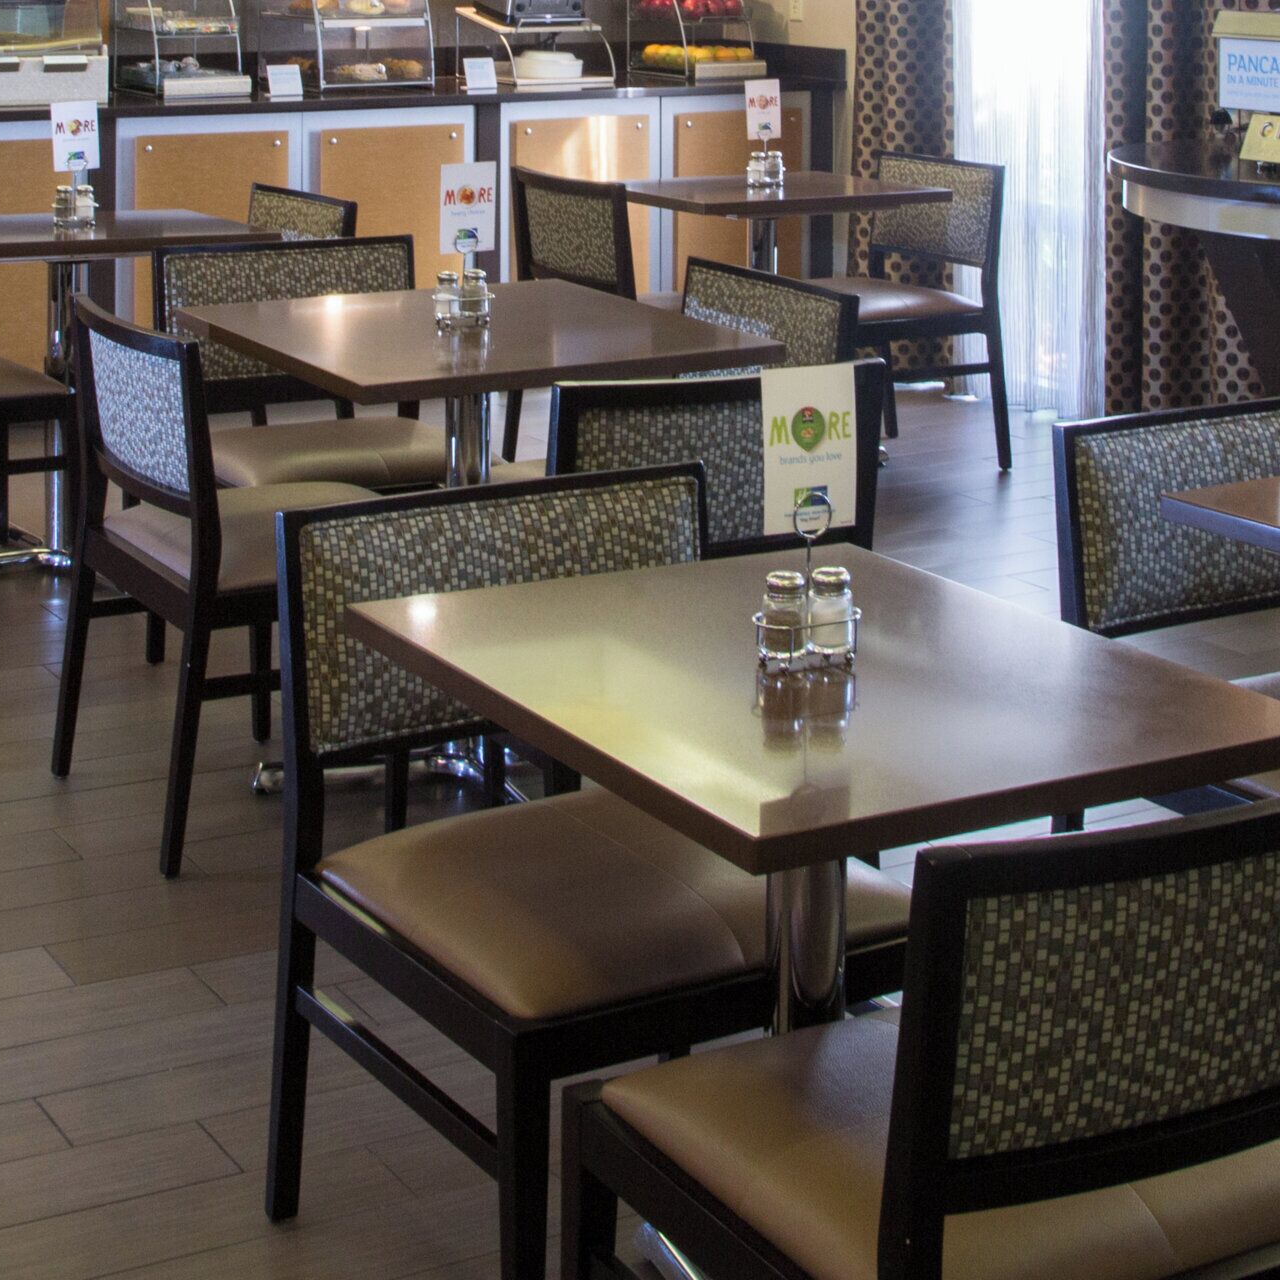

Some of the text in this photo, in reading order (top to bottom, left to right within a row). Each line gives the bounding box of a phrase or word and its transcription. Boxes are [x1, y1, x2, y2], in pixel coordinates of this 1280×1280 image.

[1227, 74, 1237, 85] IN
[1238, 75, 1245, 85] A
[1246, 76, 1278, 89] MINUTE
[444, 185, 493, 207] MORE
[770, 408, 852, 450] MORE
[779, 450, 842, 466] brands you love
